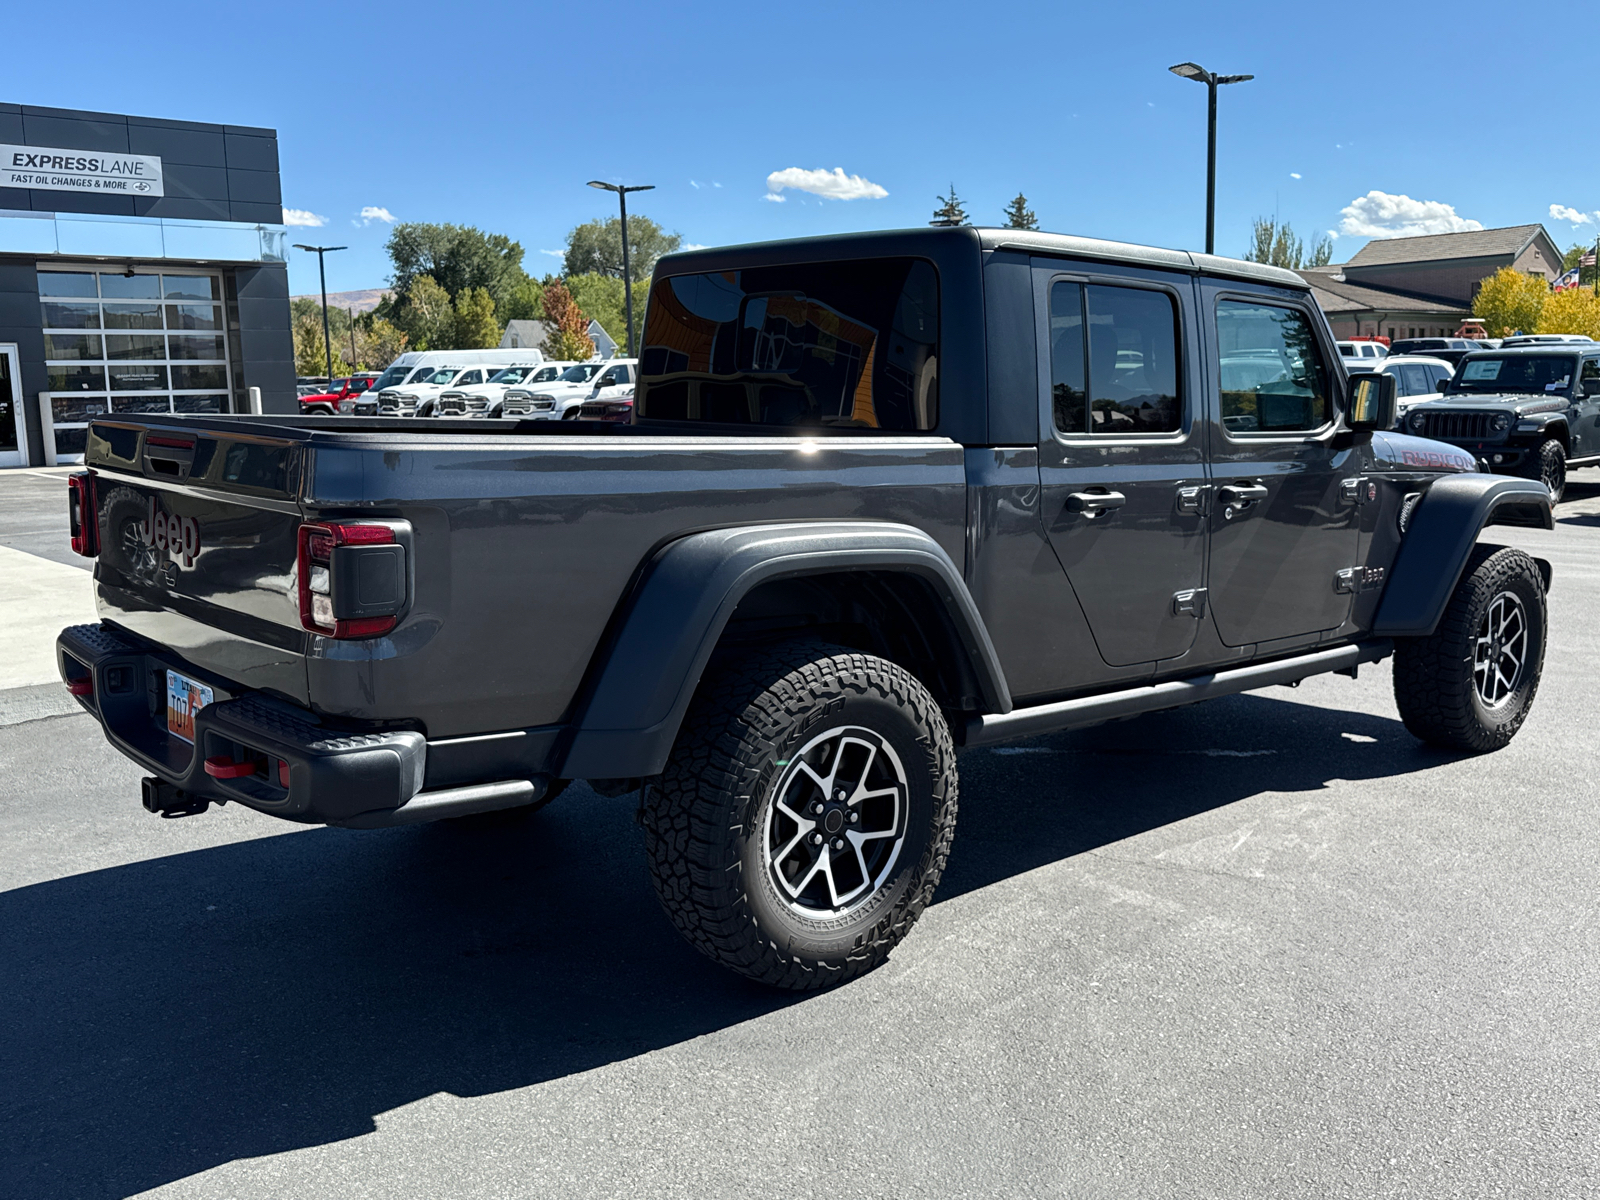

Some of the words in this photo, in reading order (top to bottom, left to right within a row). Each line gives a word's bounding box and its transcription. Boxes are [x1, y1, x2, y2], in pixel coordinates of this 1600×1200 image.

[12, 153, 99, 172] EXPRESS
[100, 159, 144, 176] LANE
[11, 174, 34, 184] FAST
[35, 176, 49, 185] OIL
[51, 177, 93, 188] CHANGES
[94, 180, 101, 188] &
[103, 180, 128, 190] MORE
[1401, 450, 1475, 471] RUBICON
[141, 495, 201, 567] Jeep
